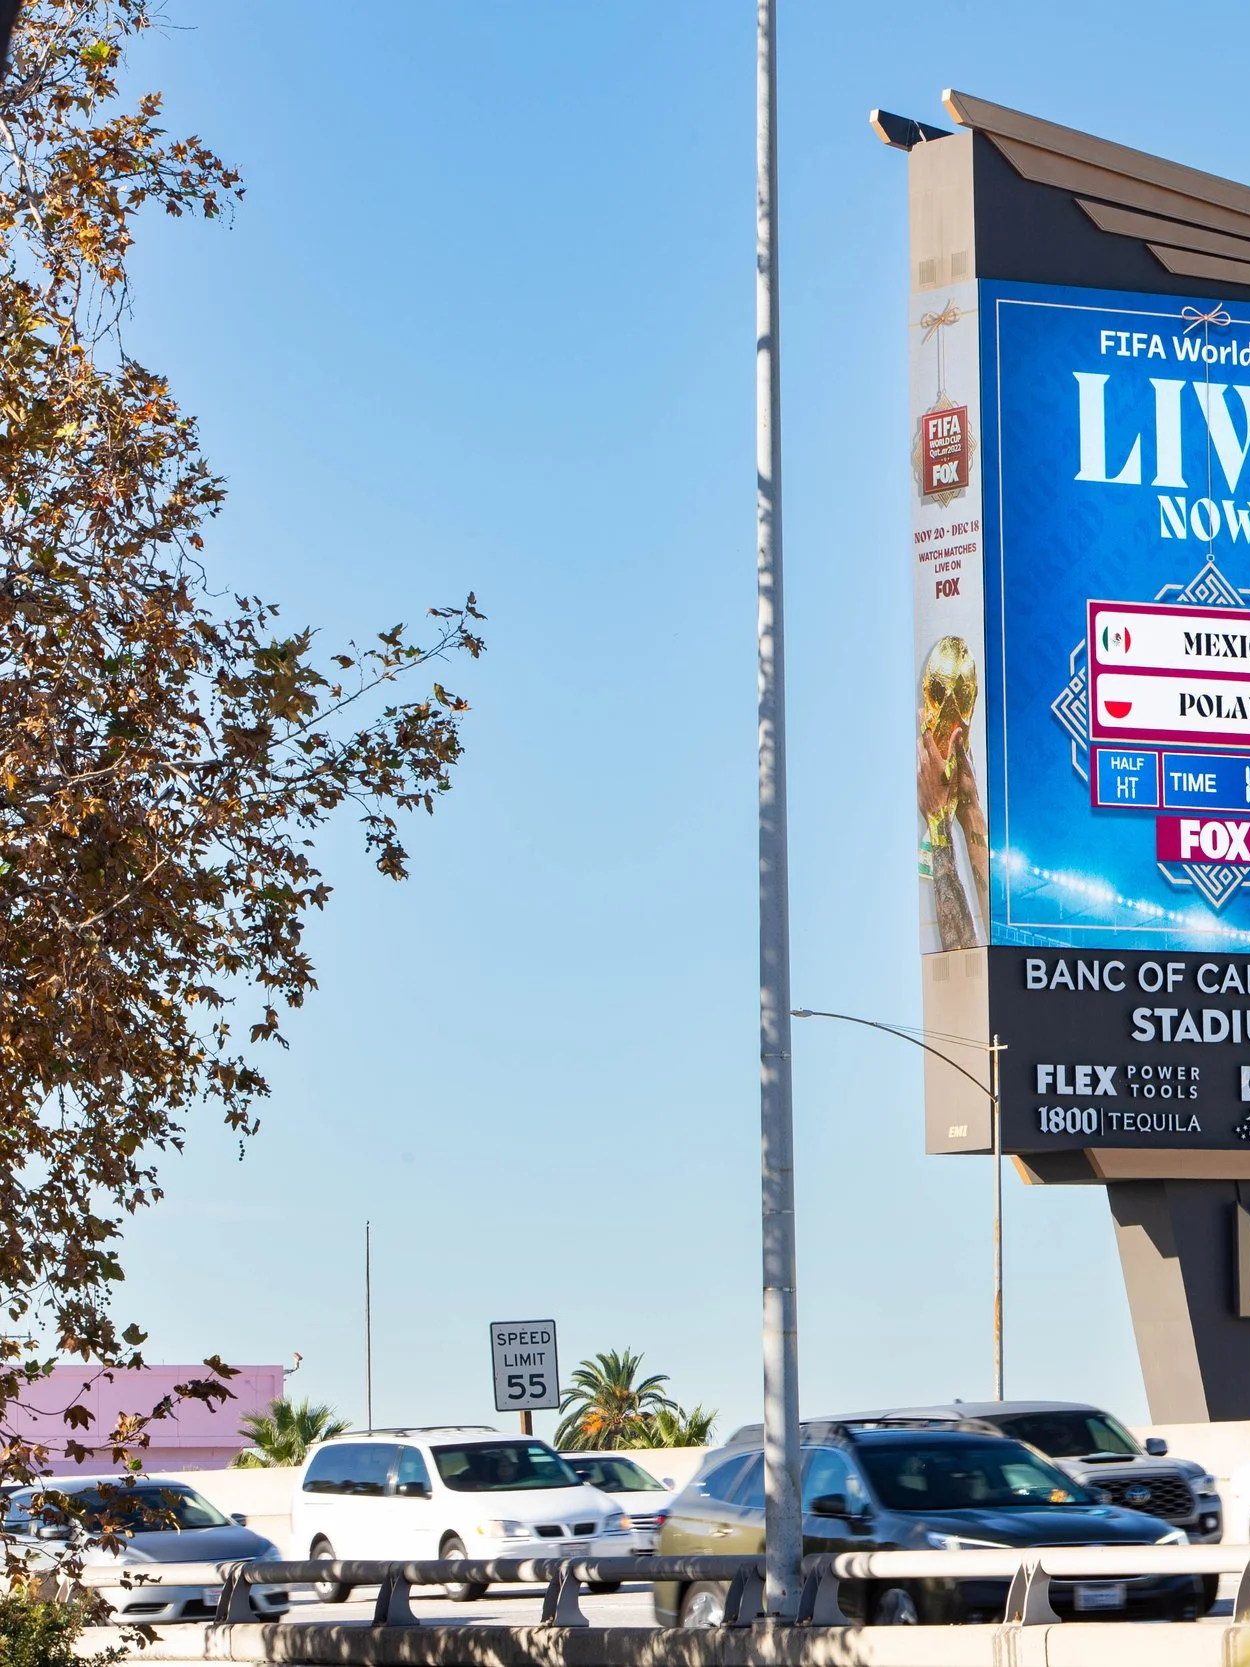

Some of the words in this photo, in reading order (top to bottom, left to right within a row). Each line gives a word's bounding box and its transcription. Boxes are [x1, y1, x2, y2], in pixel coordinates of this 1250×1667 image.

[1100, 330, 1166, 359] FIFA
[929, 415, 961, 440] FIFA
[929, 437, 950, 449] WORLD
[950, 434, 962, 444] CUP
[933, 461, 959, 486] FOX
[914, 529, 933, 544] NOV
[934, 527, 945, 540] 20
[952, 522, 969, 536] DEC
[970, 519, 980, 533] 18
[919, 549, 943, 562] WATCH
[944, 542, 977, 558] MATCHES
[934, 561, 950, 574] LIVE
[950, 559, 962, 570] ON
[935, 577, 960, 600] FOX
[1111, 756, 1145, 772] HALF
[1116, 776, 1139, 800] HT
[1169, 772, 1217, 794] TIME
[1026, 958, 1126, 993] BANC
[1137, 961, 1186, 993] OF
[1036, 1064, 1118, 1097] FLEX
[1127, 1065, 1200, 1081] POWER
[1130, 1083, 1199, 1100] TOOLS
[1038, 1105, 1098, 1135] 1800
[1108, 1112, 1202, 1133] TEQUILA
[497, 1330, 551, 1346] SPEED
[504, 1352, 546, 1368] LIMIT
[507, 1373, 547, 1400] 55
